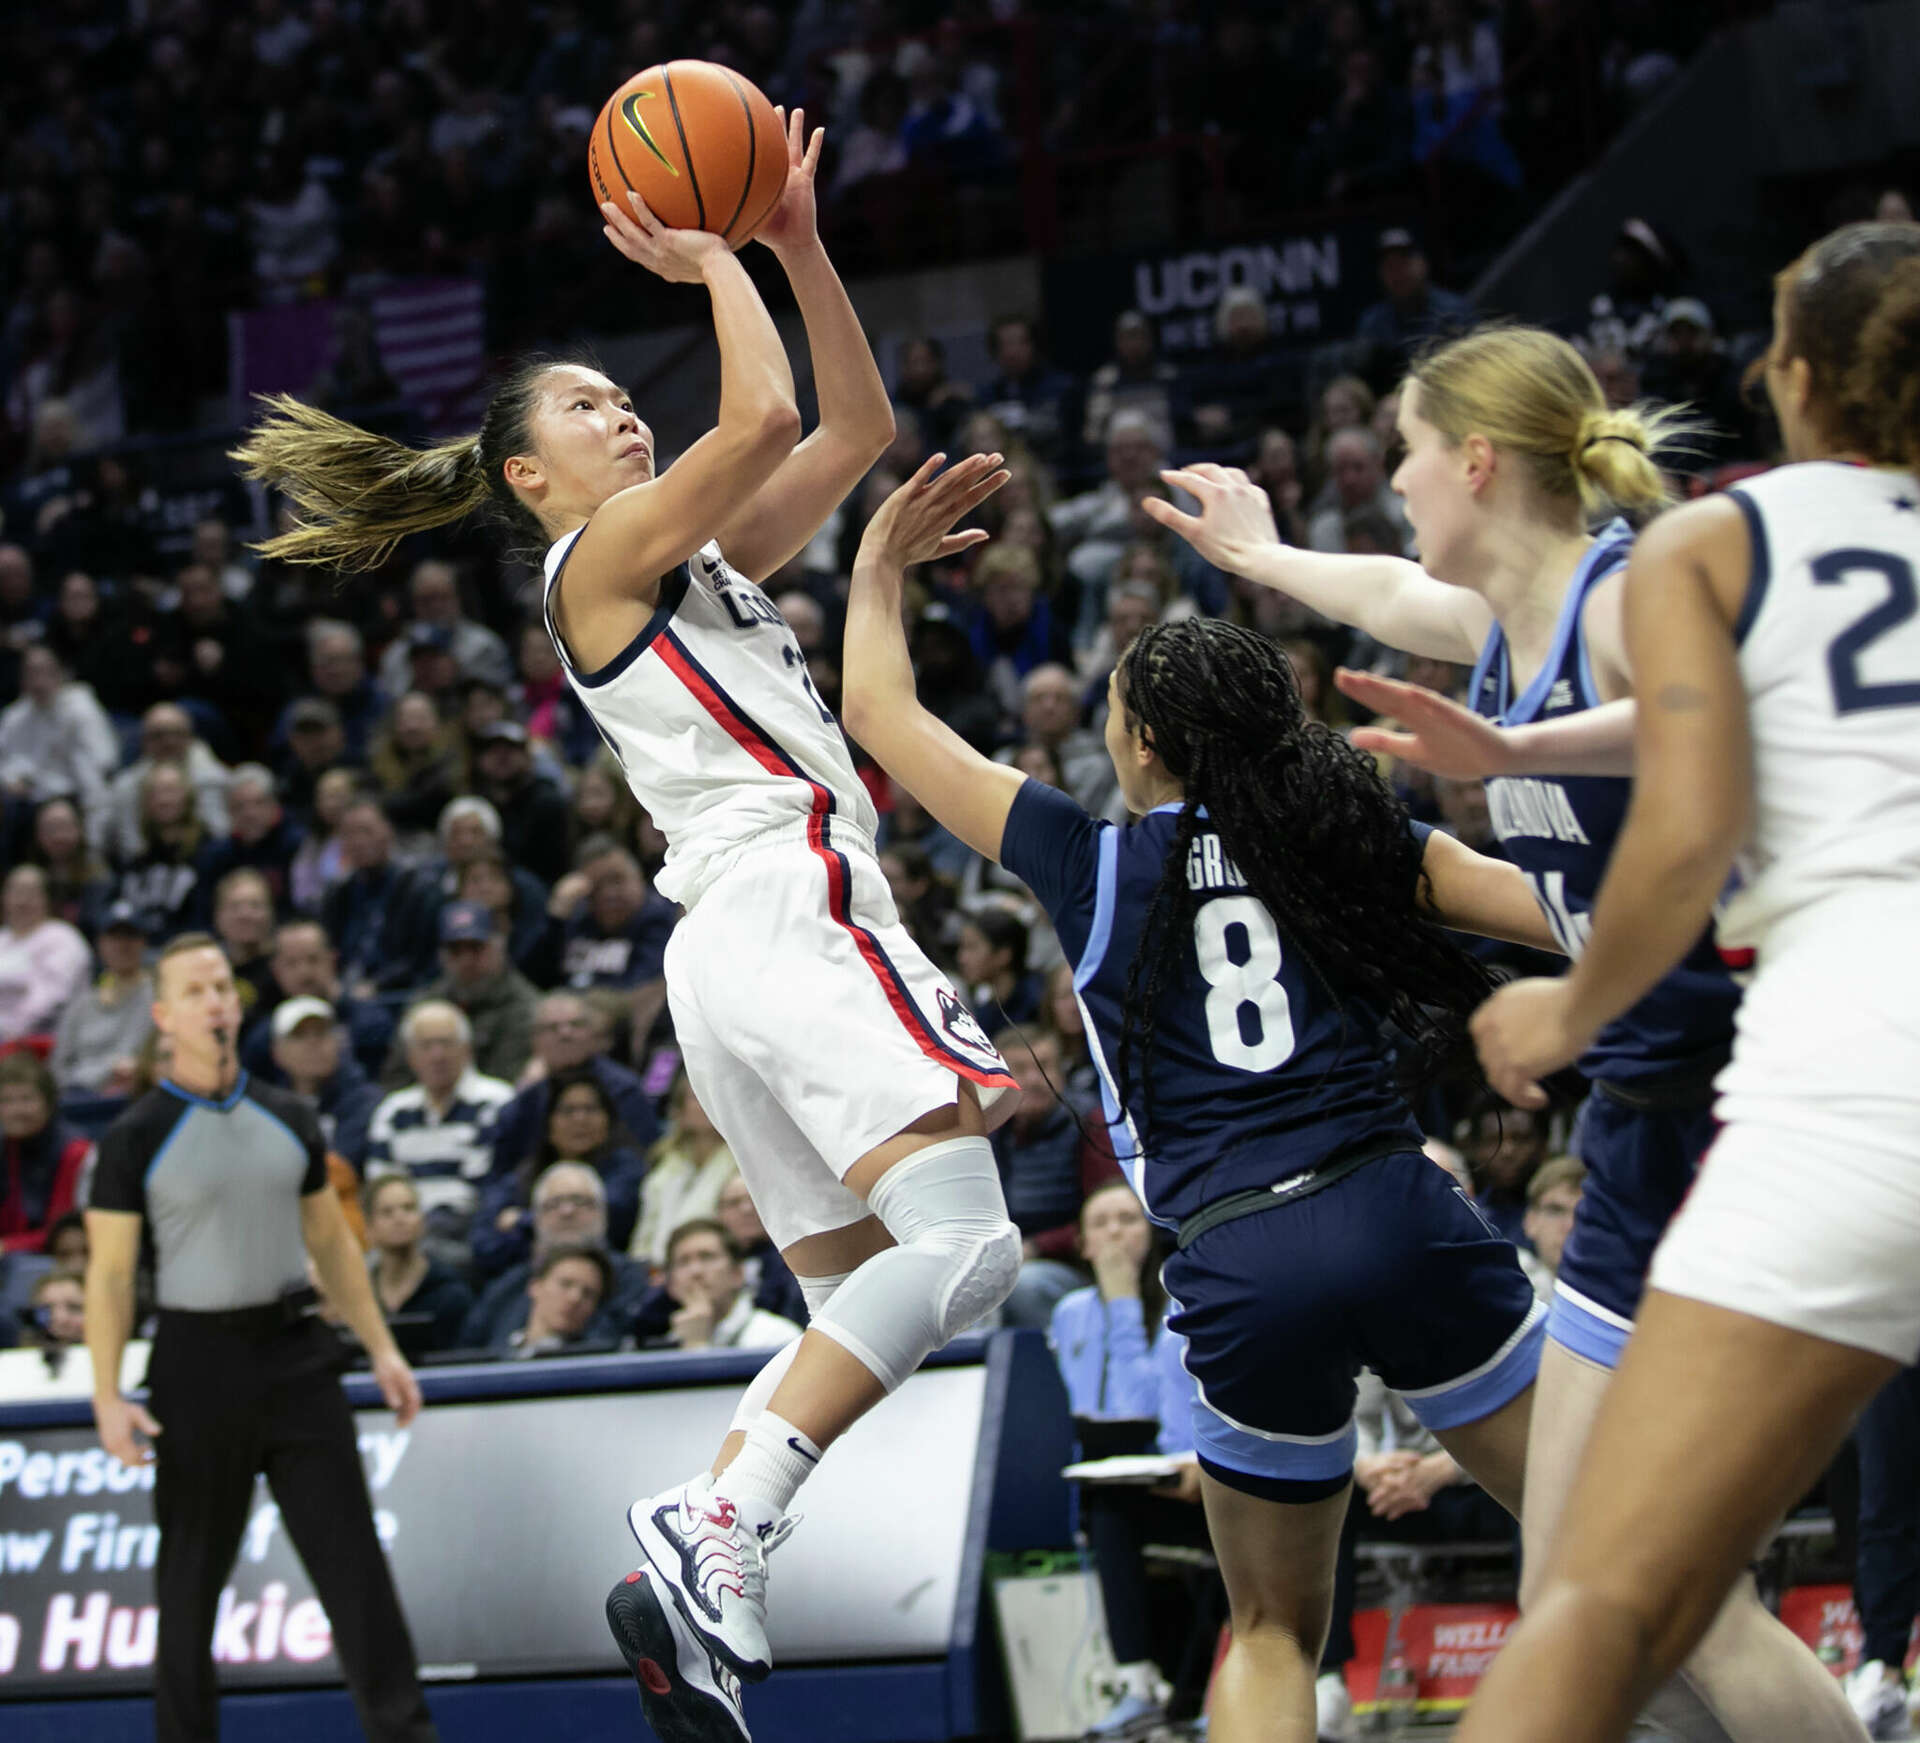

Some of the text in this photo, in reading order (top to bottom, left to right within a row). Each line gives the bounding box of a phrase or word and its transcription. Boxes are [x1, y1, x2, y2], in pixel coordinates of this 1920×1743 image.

[1135, 234, 1338, 314] UCONN
[1194, 895, 1296, 1073] 8
[40, 1581, 332, 1672] Hukie
[1433, 1620, 1514, 1650] WELL
